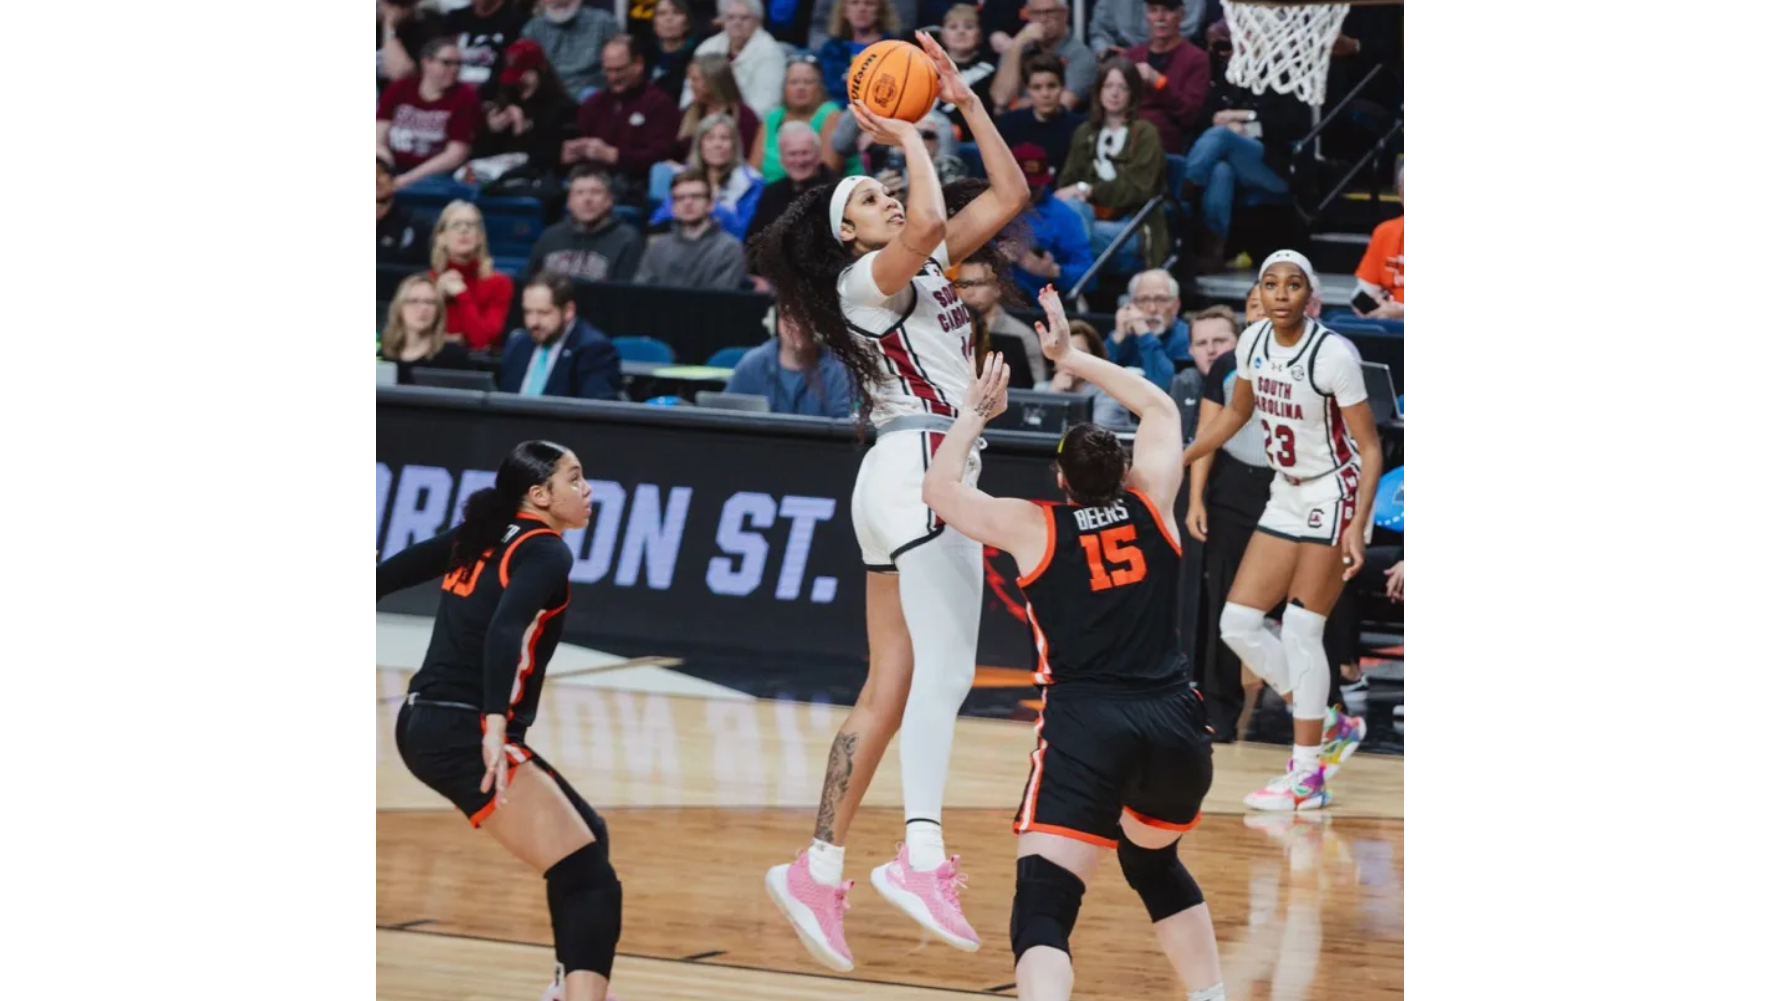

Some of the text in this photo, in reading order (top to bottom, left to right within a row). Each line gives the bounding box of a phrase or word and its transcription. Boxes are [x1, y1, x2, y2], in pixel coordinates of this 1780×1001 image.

[1258, 376, 1292, 400] SOUTH
[1254, 396, 1304, 420] AROLINA
[1073, 498, 1130, 530] BEERS
[706, 491, 839, 603] ST.
[1079, 524, 1148, 592] 15
